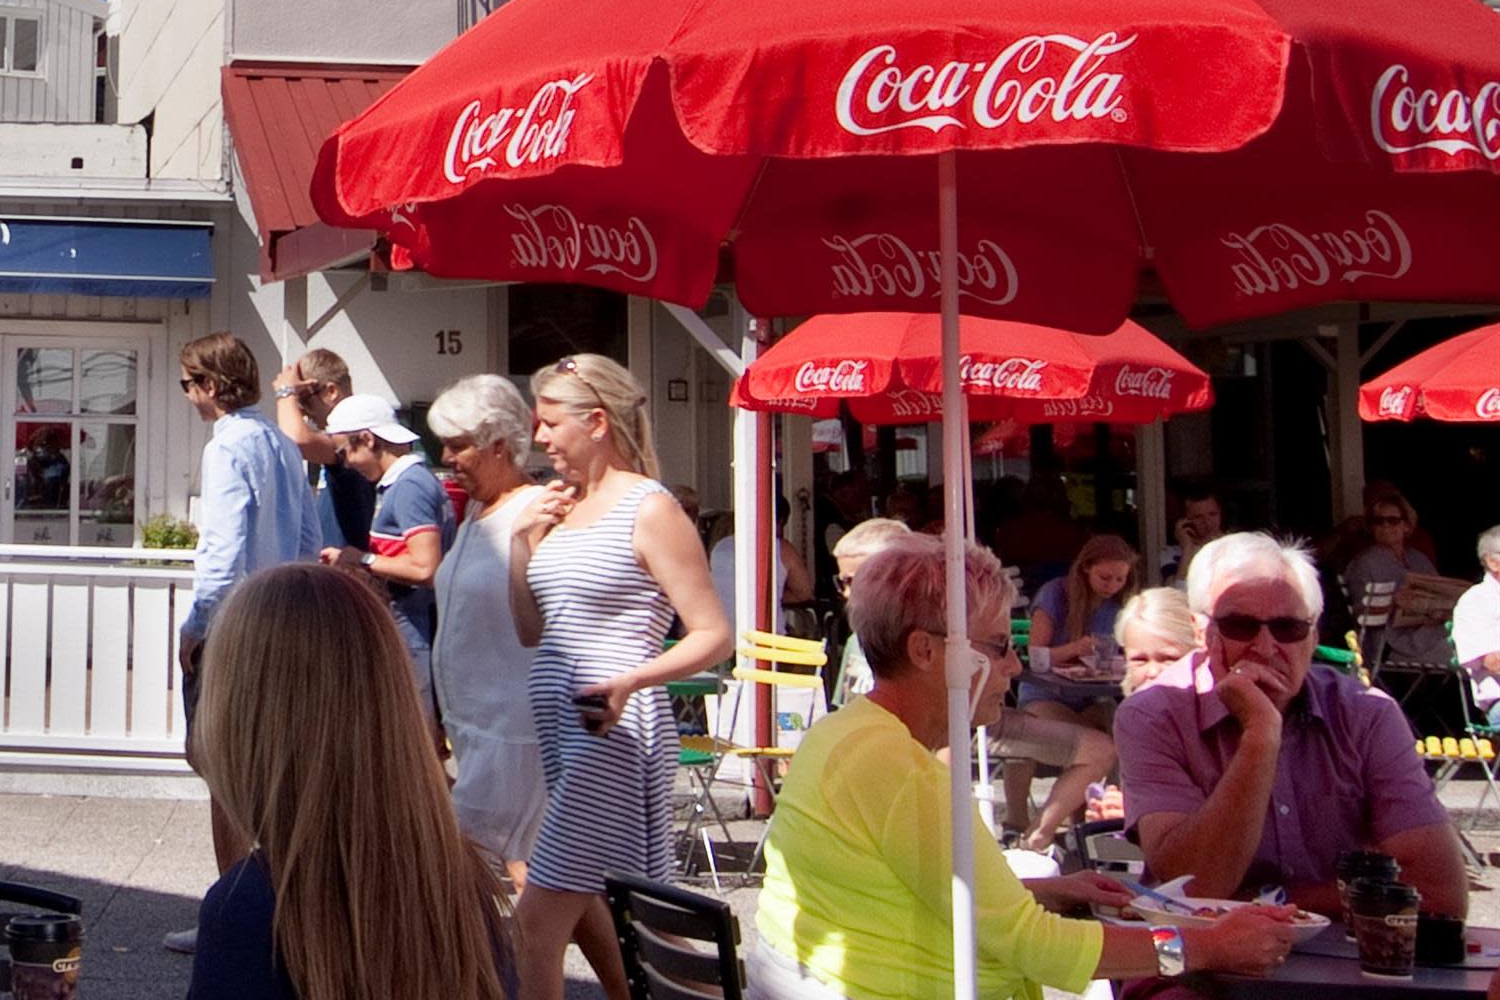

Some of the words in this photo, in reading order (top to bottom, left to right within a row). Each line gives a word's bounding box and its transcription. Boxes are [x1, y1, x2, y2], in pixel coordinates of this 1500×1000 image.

[836, 31, 1138, 136] Coca-Cola
[444, 72, 595, 184] Coca-Cola
[434, 330, 462, 355] 15
[795, 360, 868, 393] Coca-Cola
[1115, 364, 1176, 398] Coca-Cola
